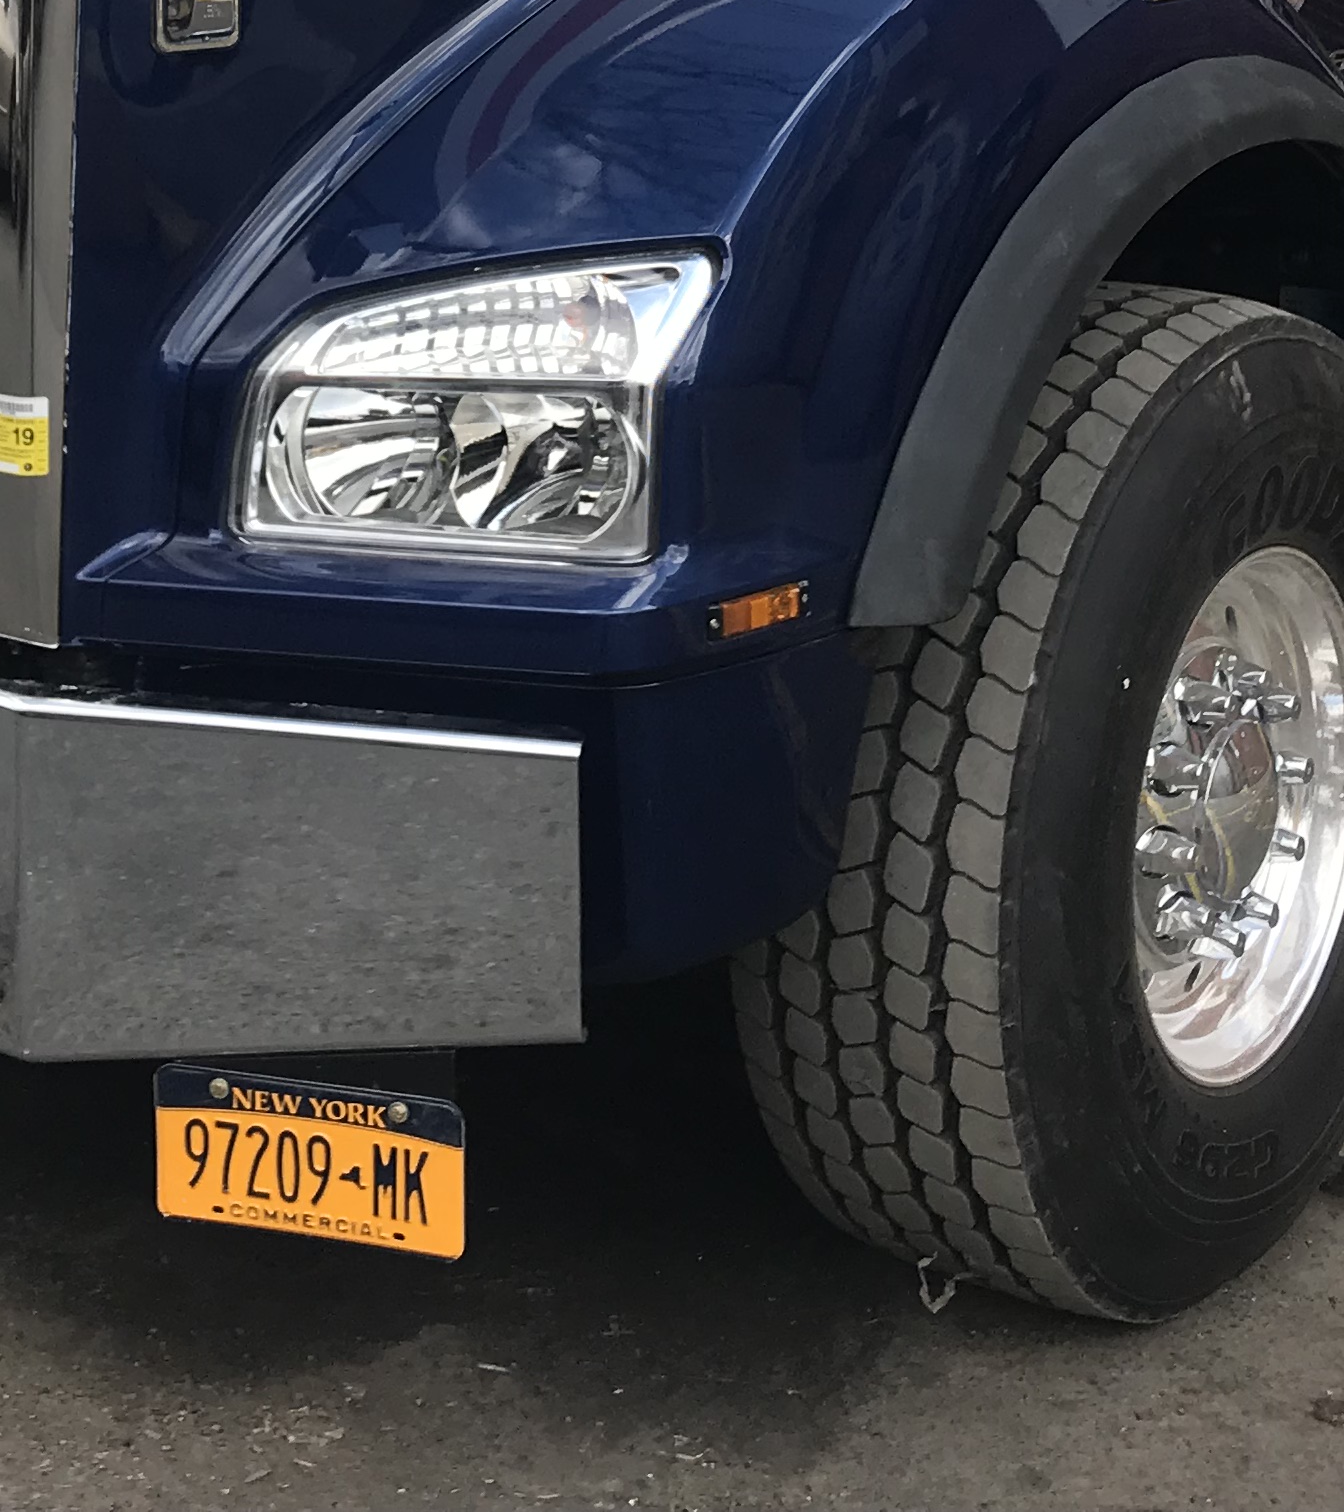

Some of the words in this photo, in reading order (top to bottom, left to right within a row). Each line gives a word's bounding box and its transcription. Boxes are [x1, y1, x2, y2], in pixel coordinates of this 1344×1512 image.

[13, 427, 35, 446] 19
[232, 1086, 304, 1118] NEW
[307, 1096, 389, 1130] YORK
[184, 1118, 333, 1207] 97209
[228, 1202, 390, 1241] COMMERCIAL
